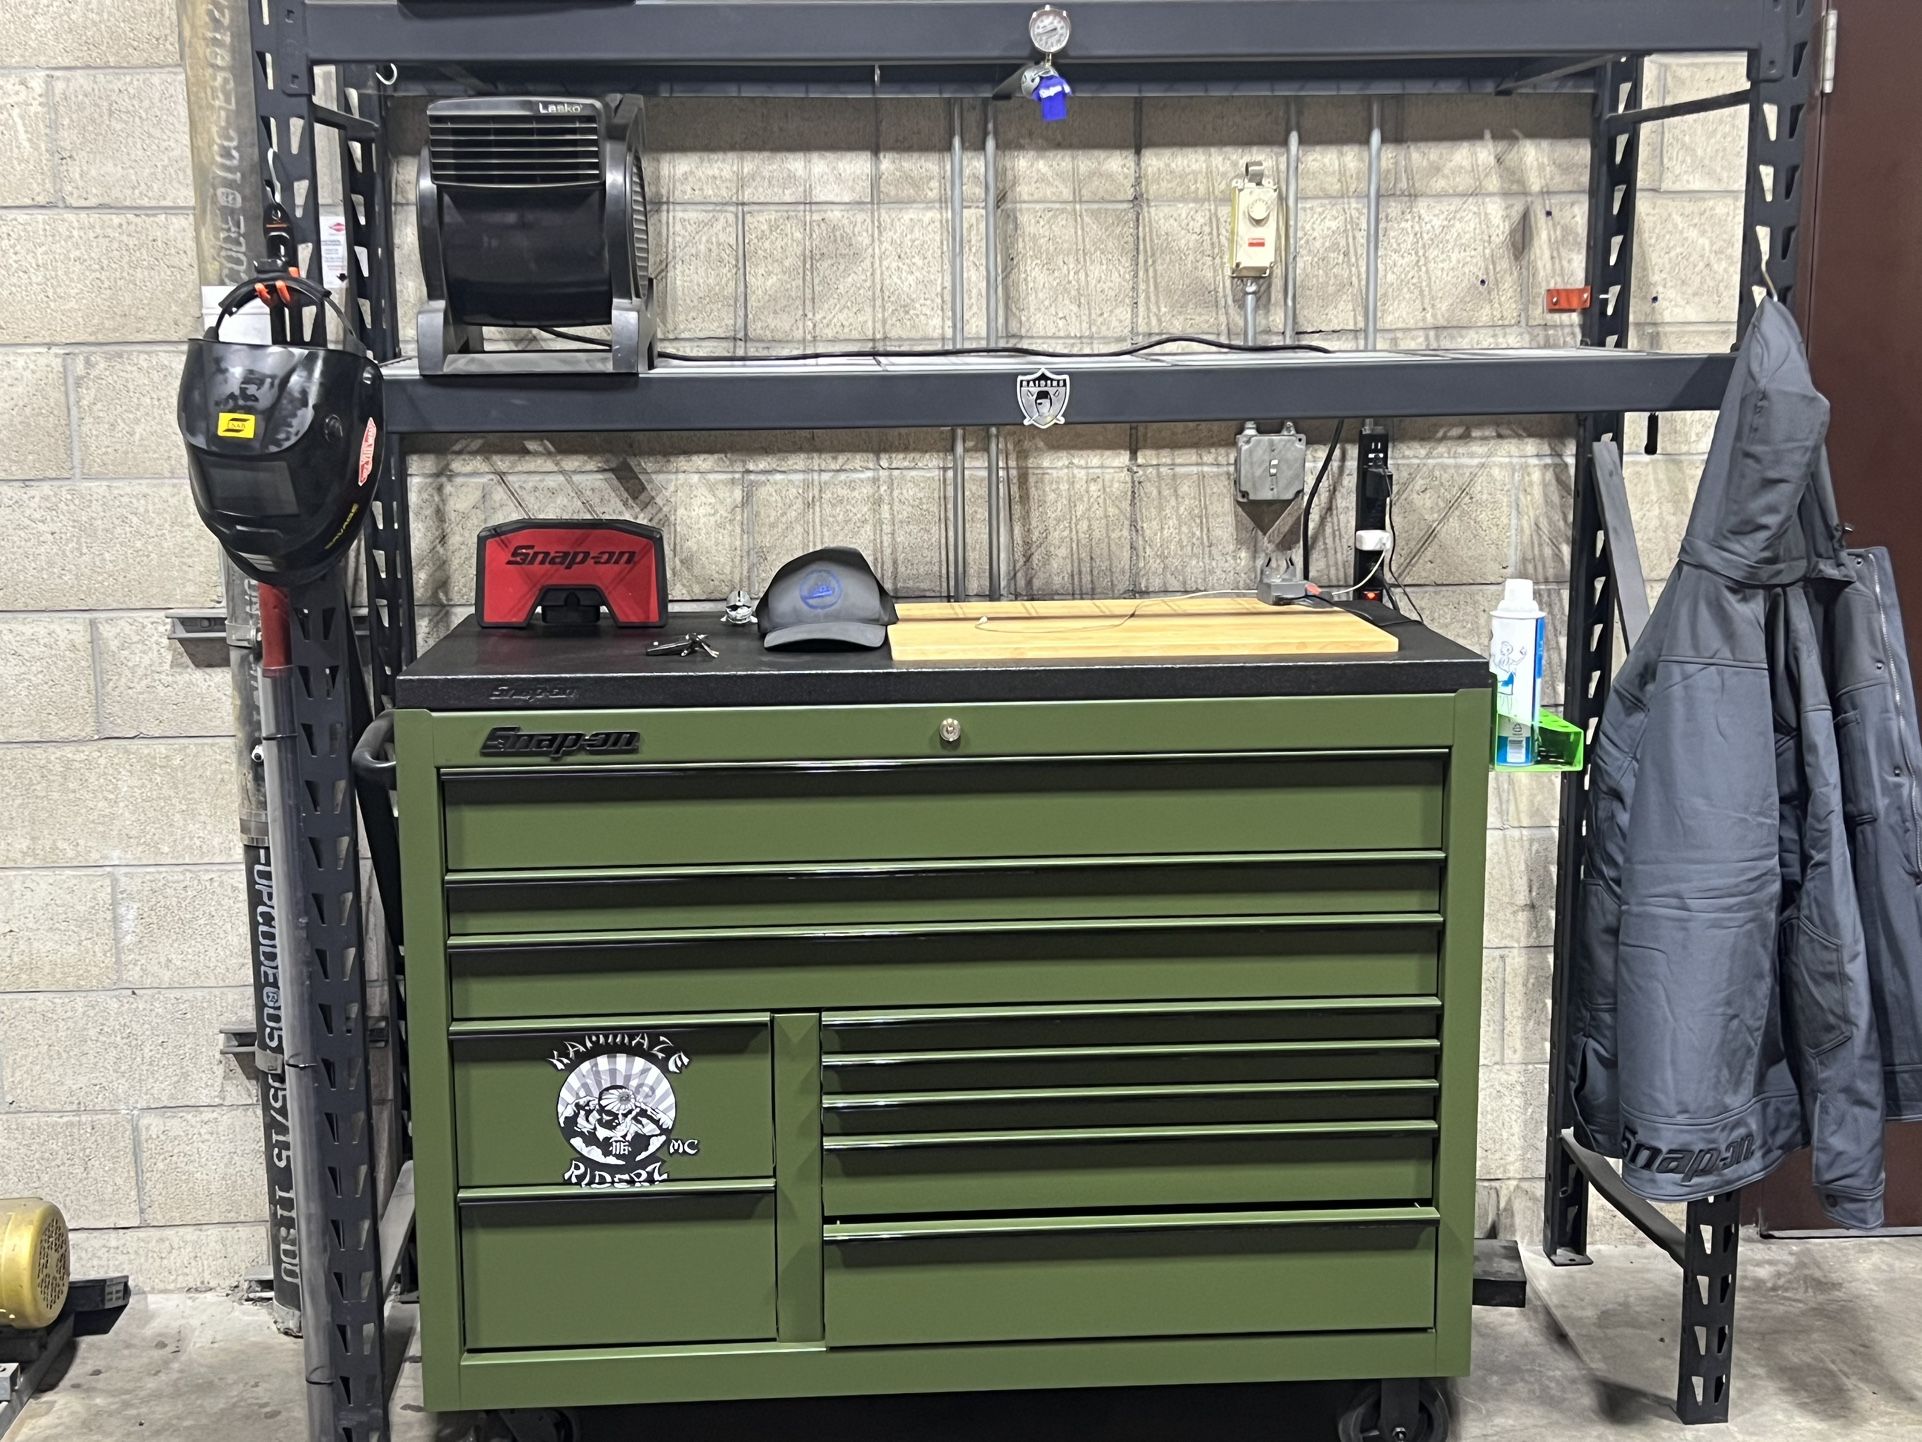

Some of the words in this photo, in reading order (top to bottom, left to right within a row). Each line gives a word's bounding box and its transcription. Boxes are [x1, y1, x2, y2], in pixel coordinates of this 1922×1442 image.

[539, 102, 581, 114] Lasko
[505, 544, 637, 570] Snap-on
[488, 685, 578, 702] Snap-on
[480, 726, 640, 761] Snap-on
[669, 1139, 699, 1155] MC
